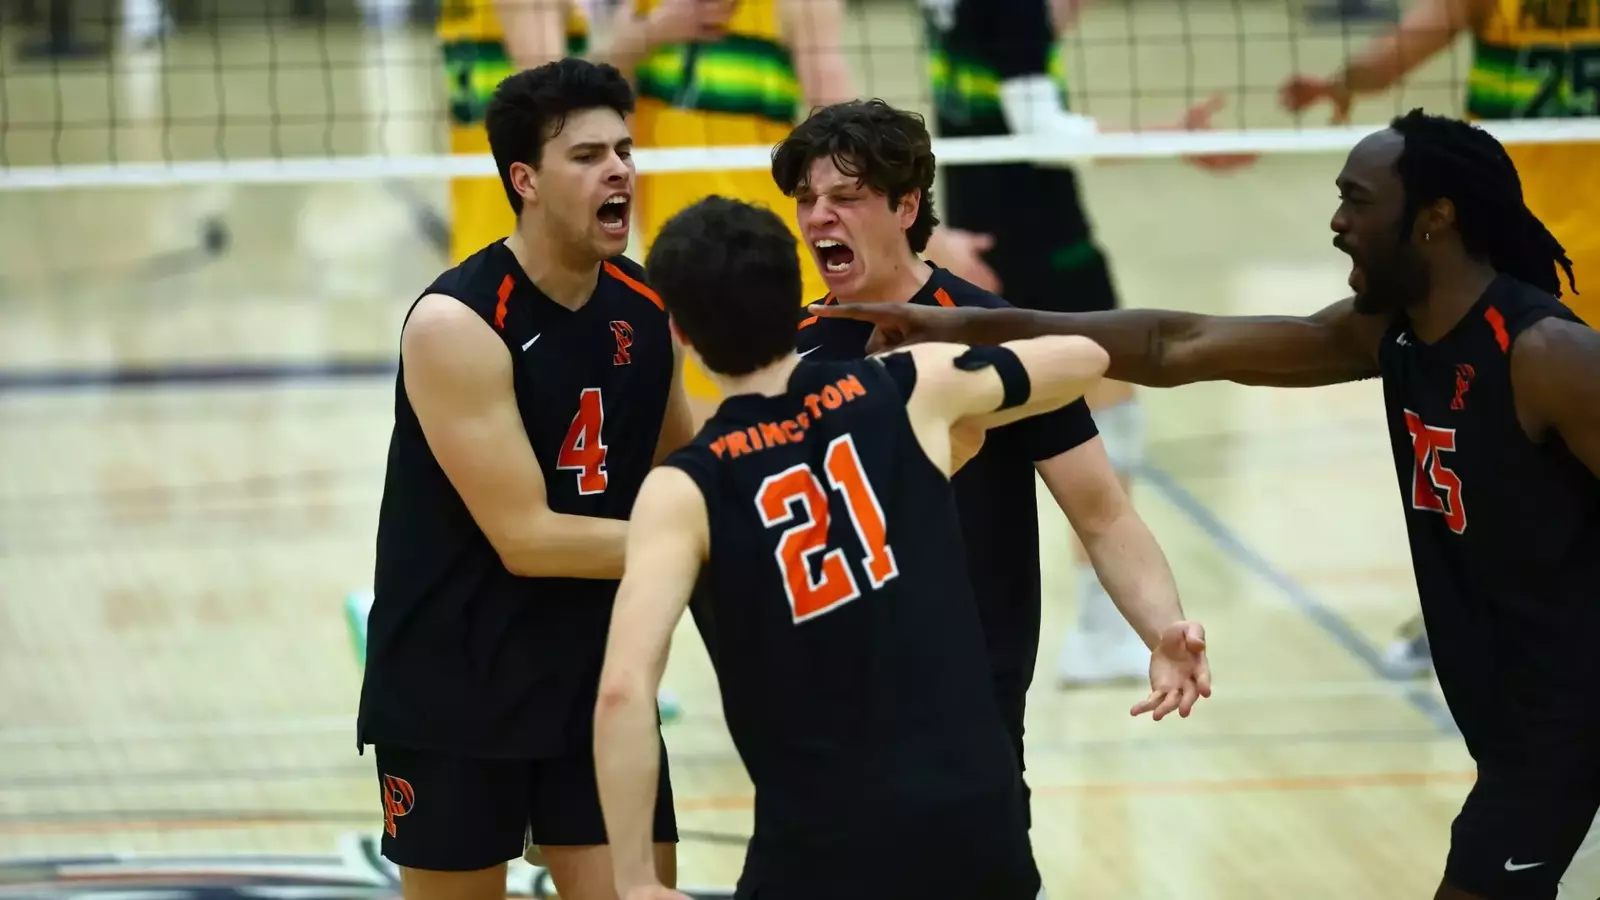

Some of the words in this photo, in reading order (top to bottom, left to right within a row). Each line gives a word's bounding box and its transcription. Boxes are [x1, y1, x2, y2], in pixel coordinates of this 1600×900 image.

[556, 387, 609, 496] 4
[1403, 407, 1468, 535] 25
[753, 432, 900, 625] 21
